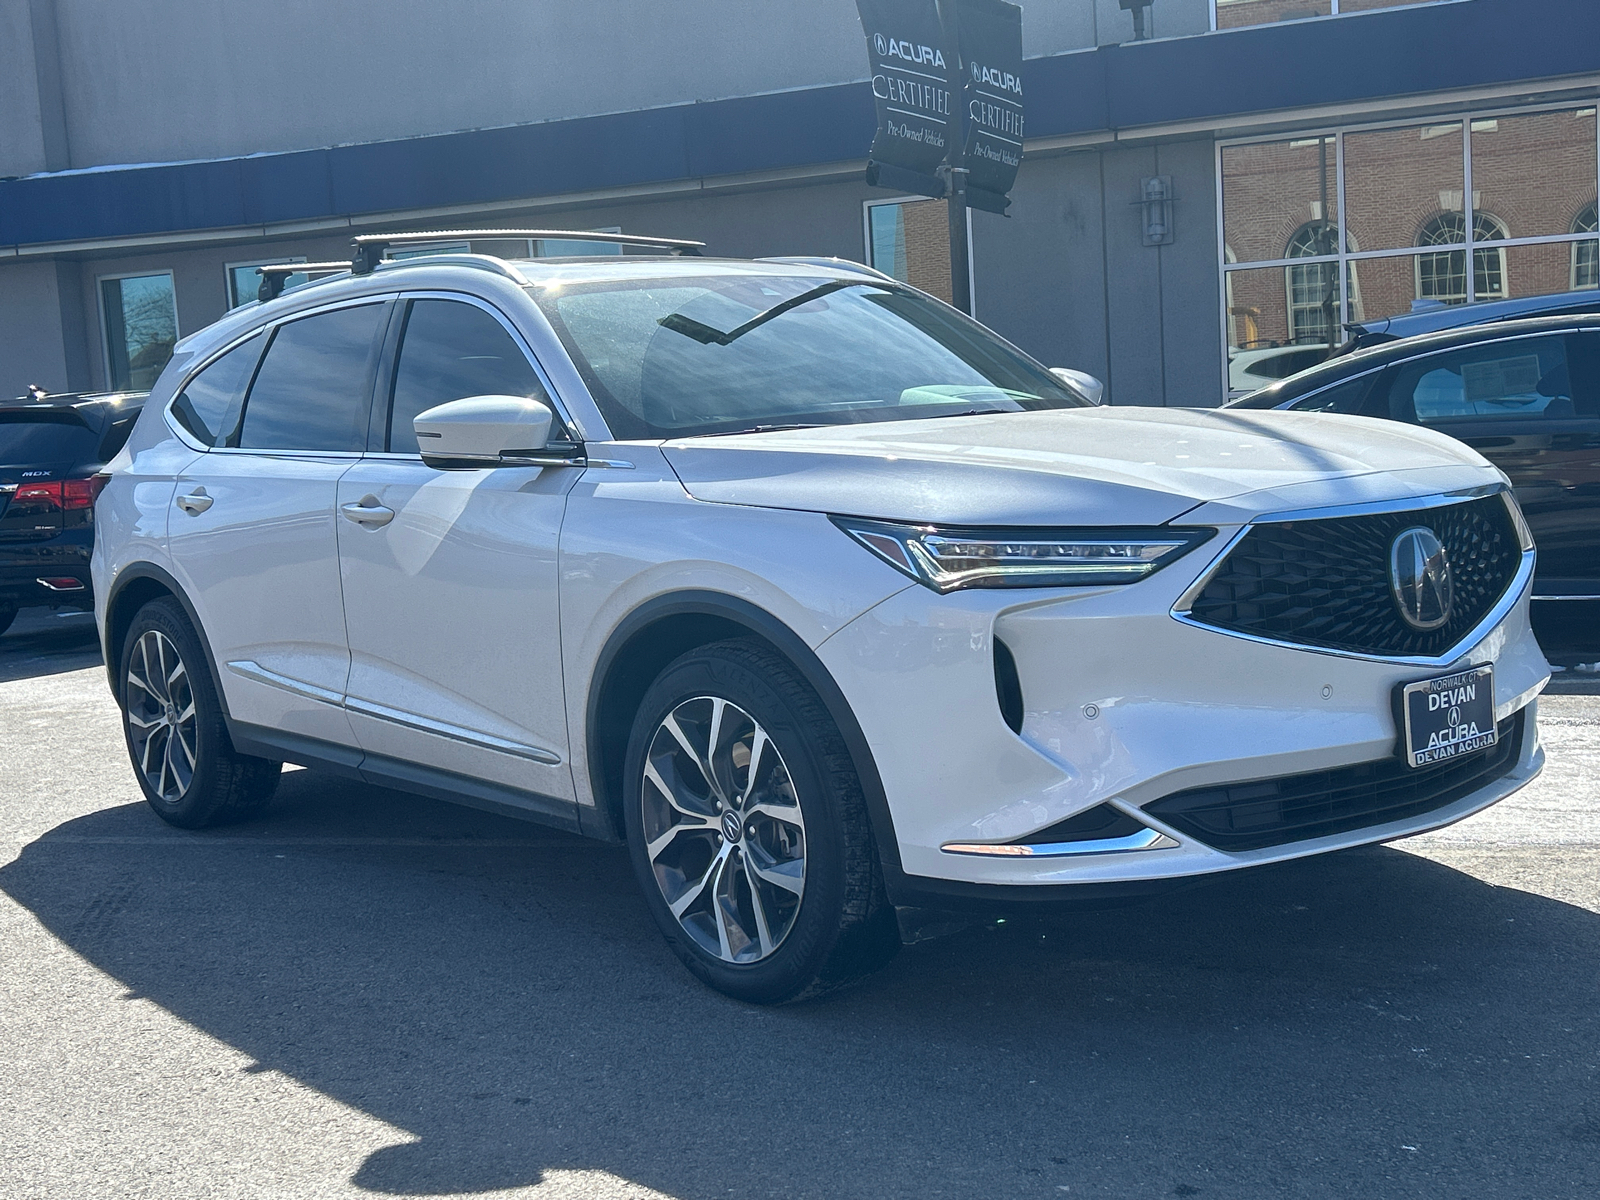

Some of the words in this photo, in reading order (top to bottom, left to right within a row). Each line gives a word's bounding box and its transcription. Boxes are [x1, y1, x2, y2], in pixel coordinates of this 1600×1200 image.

[888, 38, 946, 70] ACURA
[982, 66, 1022, 96] ACURA
[888, 120, 923, 142] Pre-Owned
[924, 128, 945, 148] Vehicles
[1428, 684, 1475, 711] DEVAN
[1416, 748, 1455, 765] DEVAN
[1458, 733, 1494, 753] ACURA
[1427, 722, 1479, 749] ACURA
